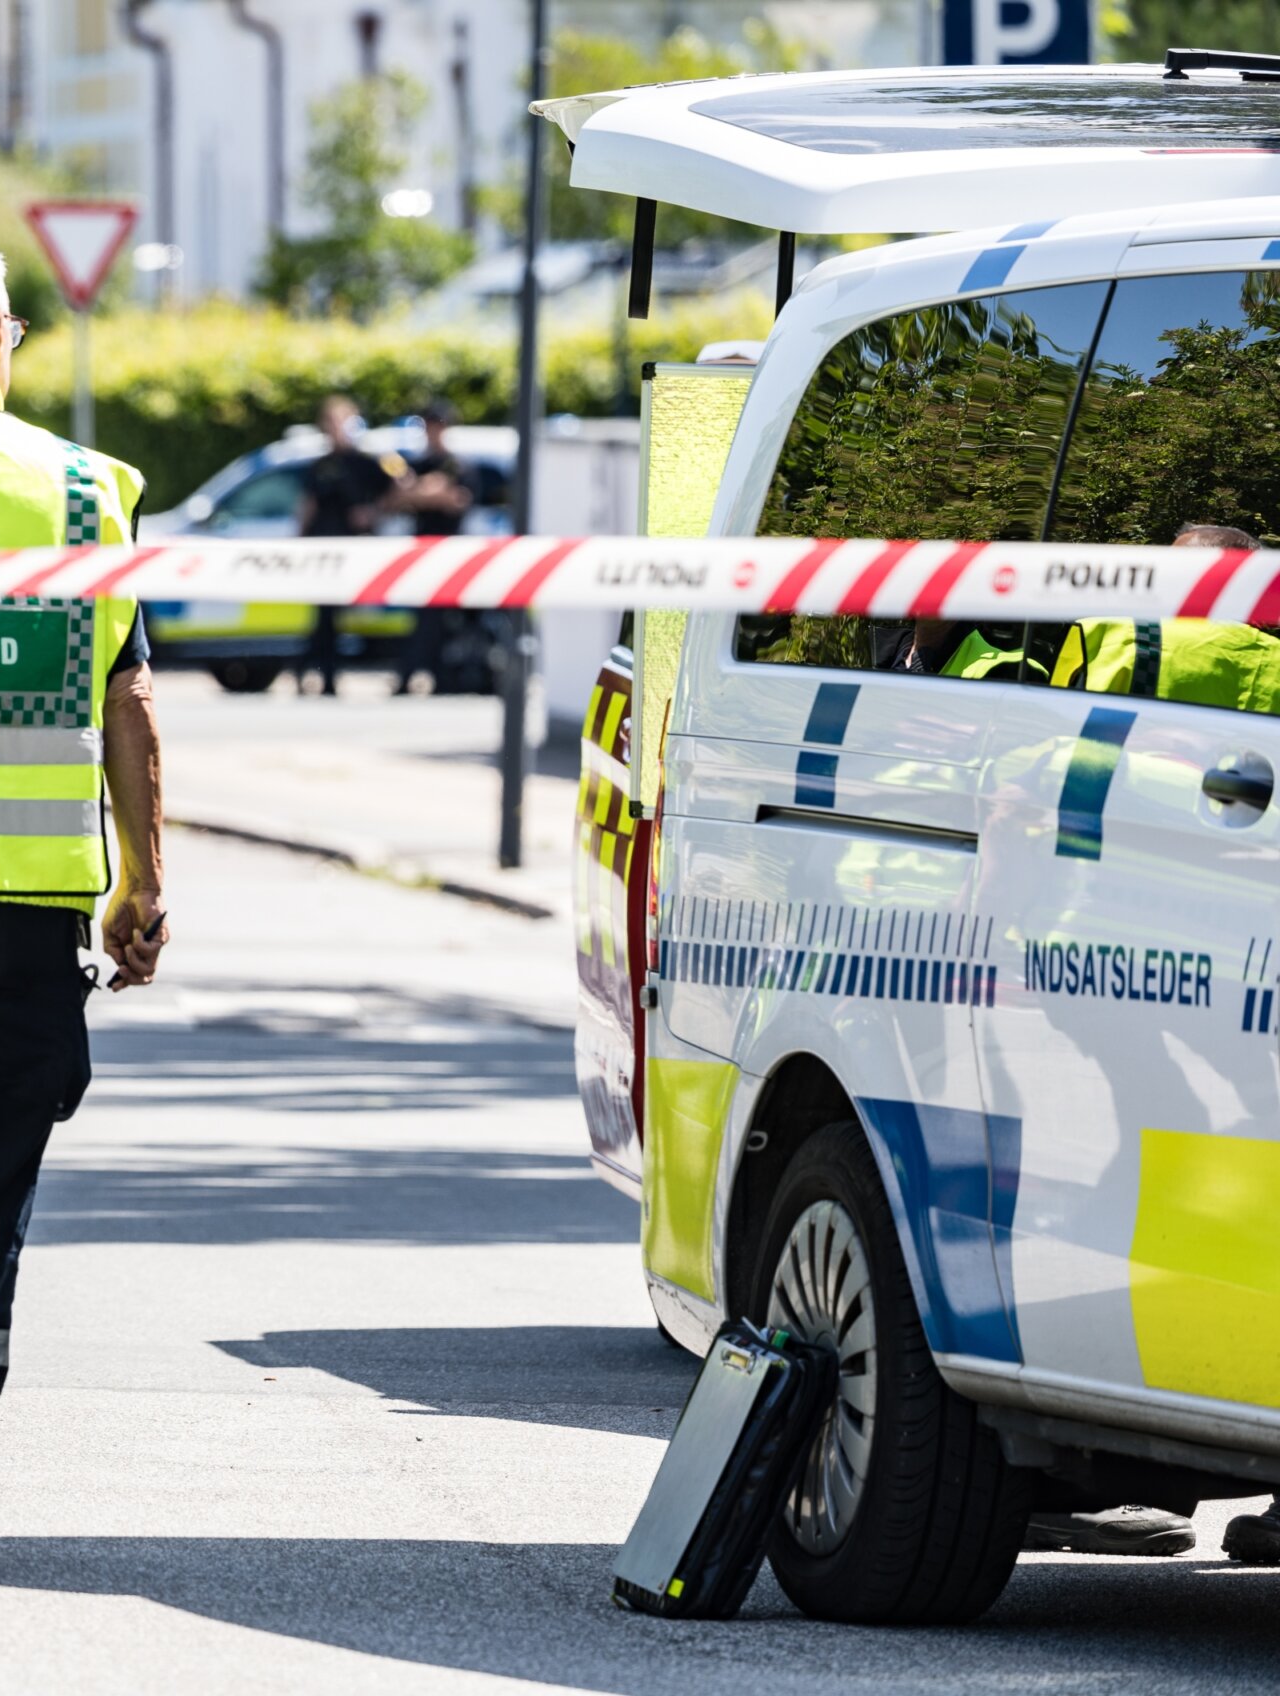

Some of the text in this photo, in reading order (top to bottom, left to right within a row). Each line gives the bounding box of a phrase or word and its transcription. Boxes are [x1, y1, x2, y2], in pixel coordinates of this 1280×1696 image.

[972, 0, 1060, 65] P
[1044, 562, 1154, 588] POLITI
[1024, 938, 1212, 1008] INDSATSLEDER
